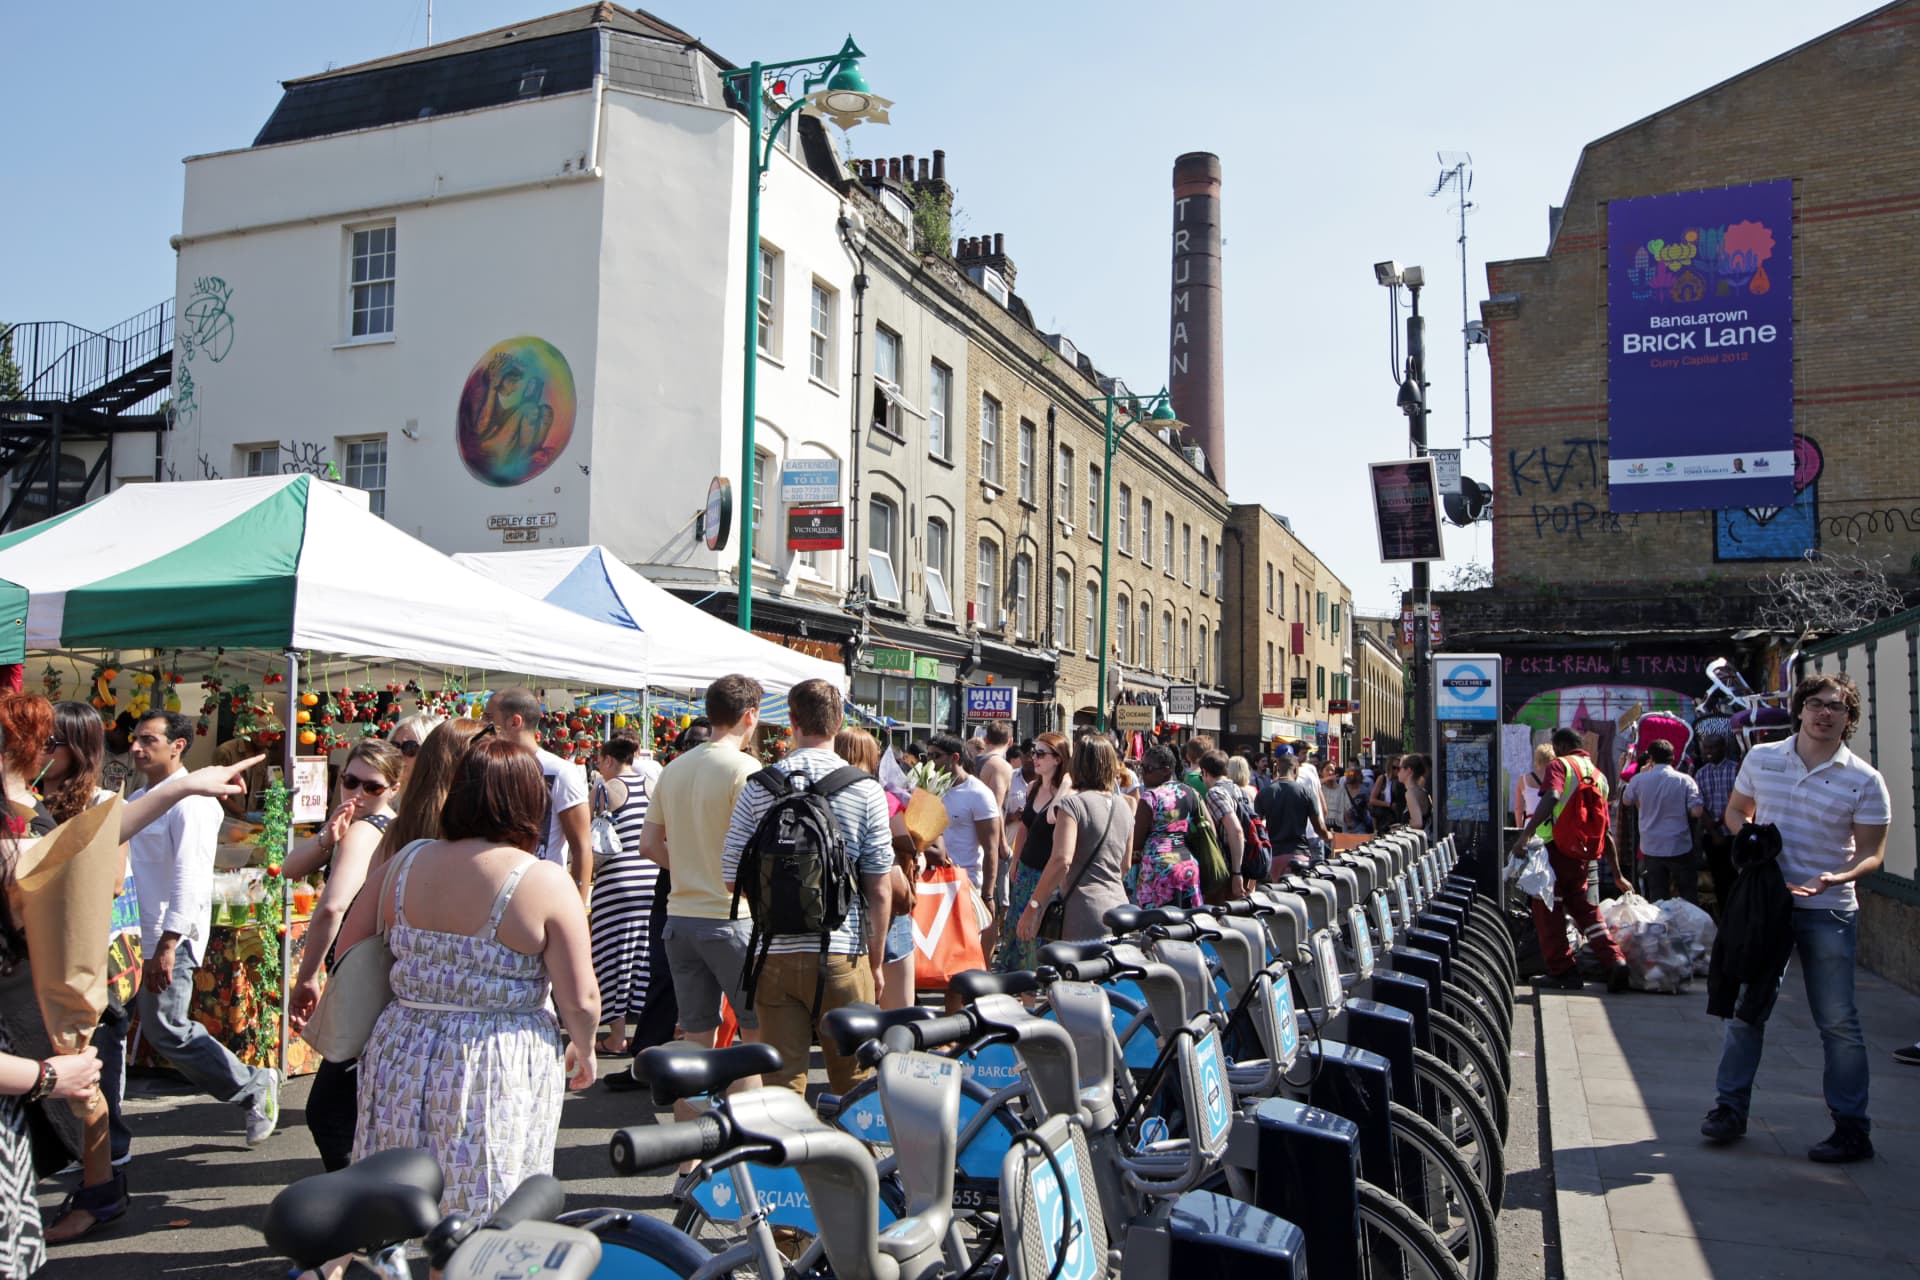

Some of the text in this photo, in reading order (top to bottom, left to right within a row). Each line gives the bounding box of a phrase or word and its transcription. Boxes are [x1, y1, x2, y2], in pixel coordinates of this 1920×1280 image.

[1172, 198, 1191, 377] TRUMAN
[1704, 324, 1777, 348] Lane
[1650, 357, 1680, 369] Curry
[1681, 353, 1720, 367] Capital
[793, 476, 830, 484] TO LET
[490, 516, 524, 527] PEDLEY
[875, 652, 908, 667] EXIT
[970, 689, 1010, 701] MINI
[974, 701, 1006, 710] CAB
